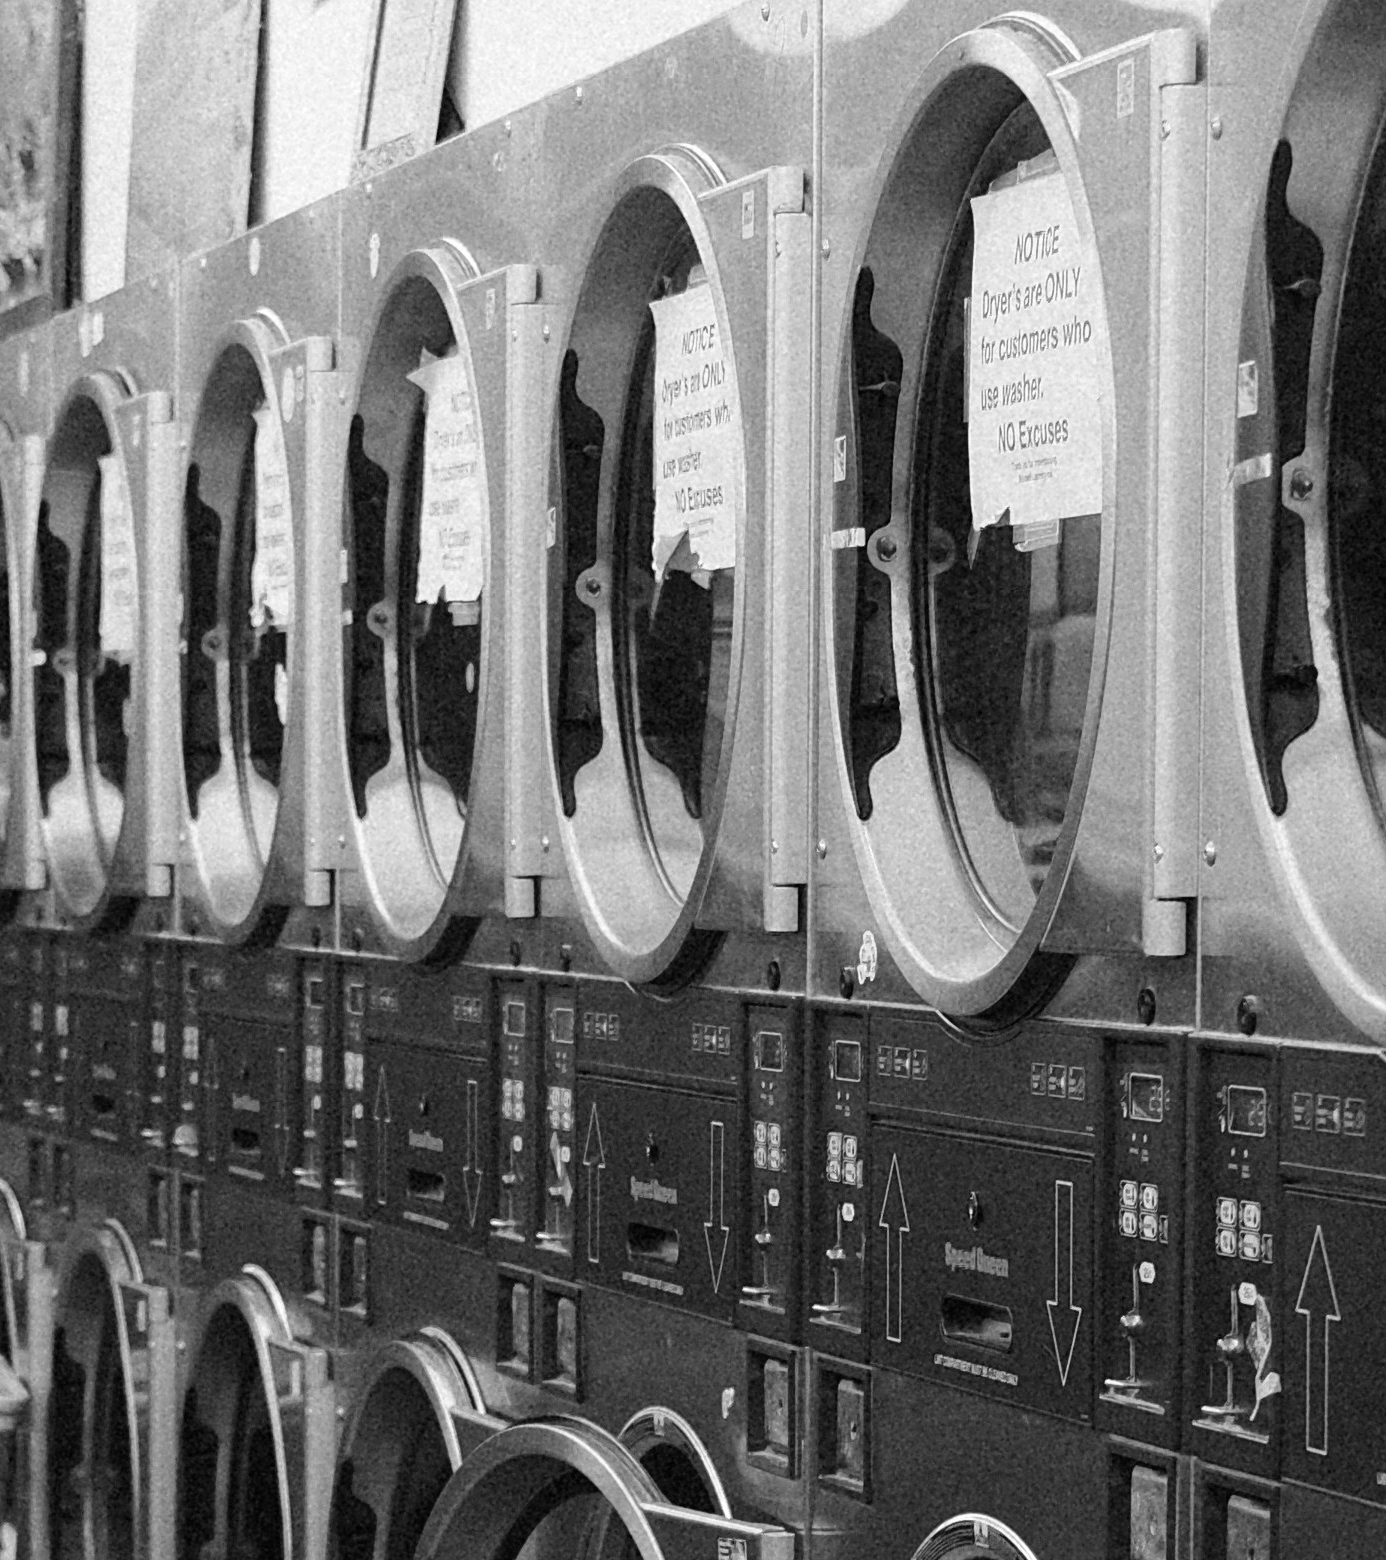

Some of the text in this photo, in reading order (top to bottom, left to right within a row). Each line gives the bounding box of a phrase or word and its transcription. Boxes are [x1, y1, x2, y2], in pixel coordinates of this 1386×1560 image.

[1014, 224, 1060, 266] NOTICE
[982, 267, 1081, 325] Dryer's are ONLY
[681, 323, 716, 356] NOTICE
[980, 315, 1092, 364] for customers who
[980, 384, 999, 411] use
[674, 406, 712, 439] customers
[998, 419, 1069, 454] NO Excuses
[662, 457, 677, 480] use
[674, 488, 686, 513] NO
